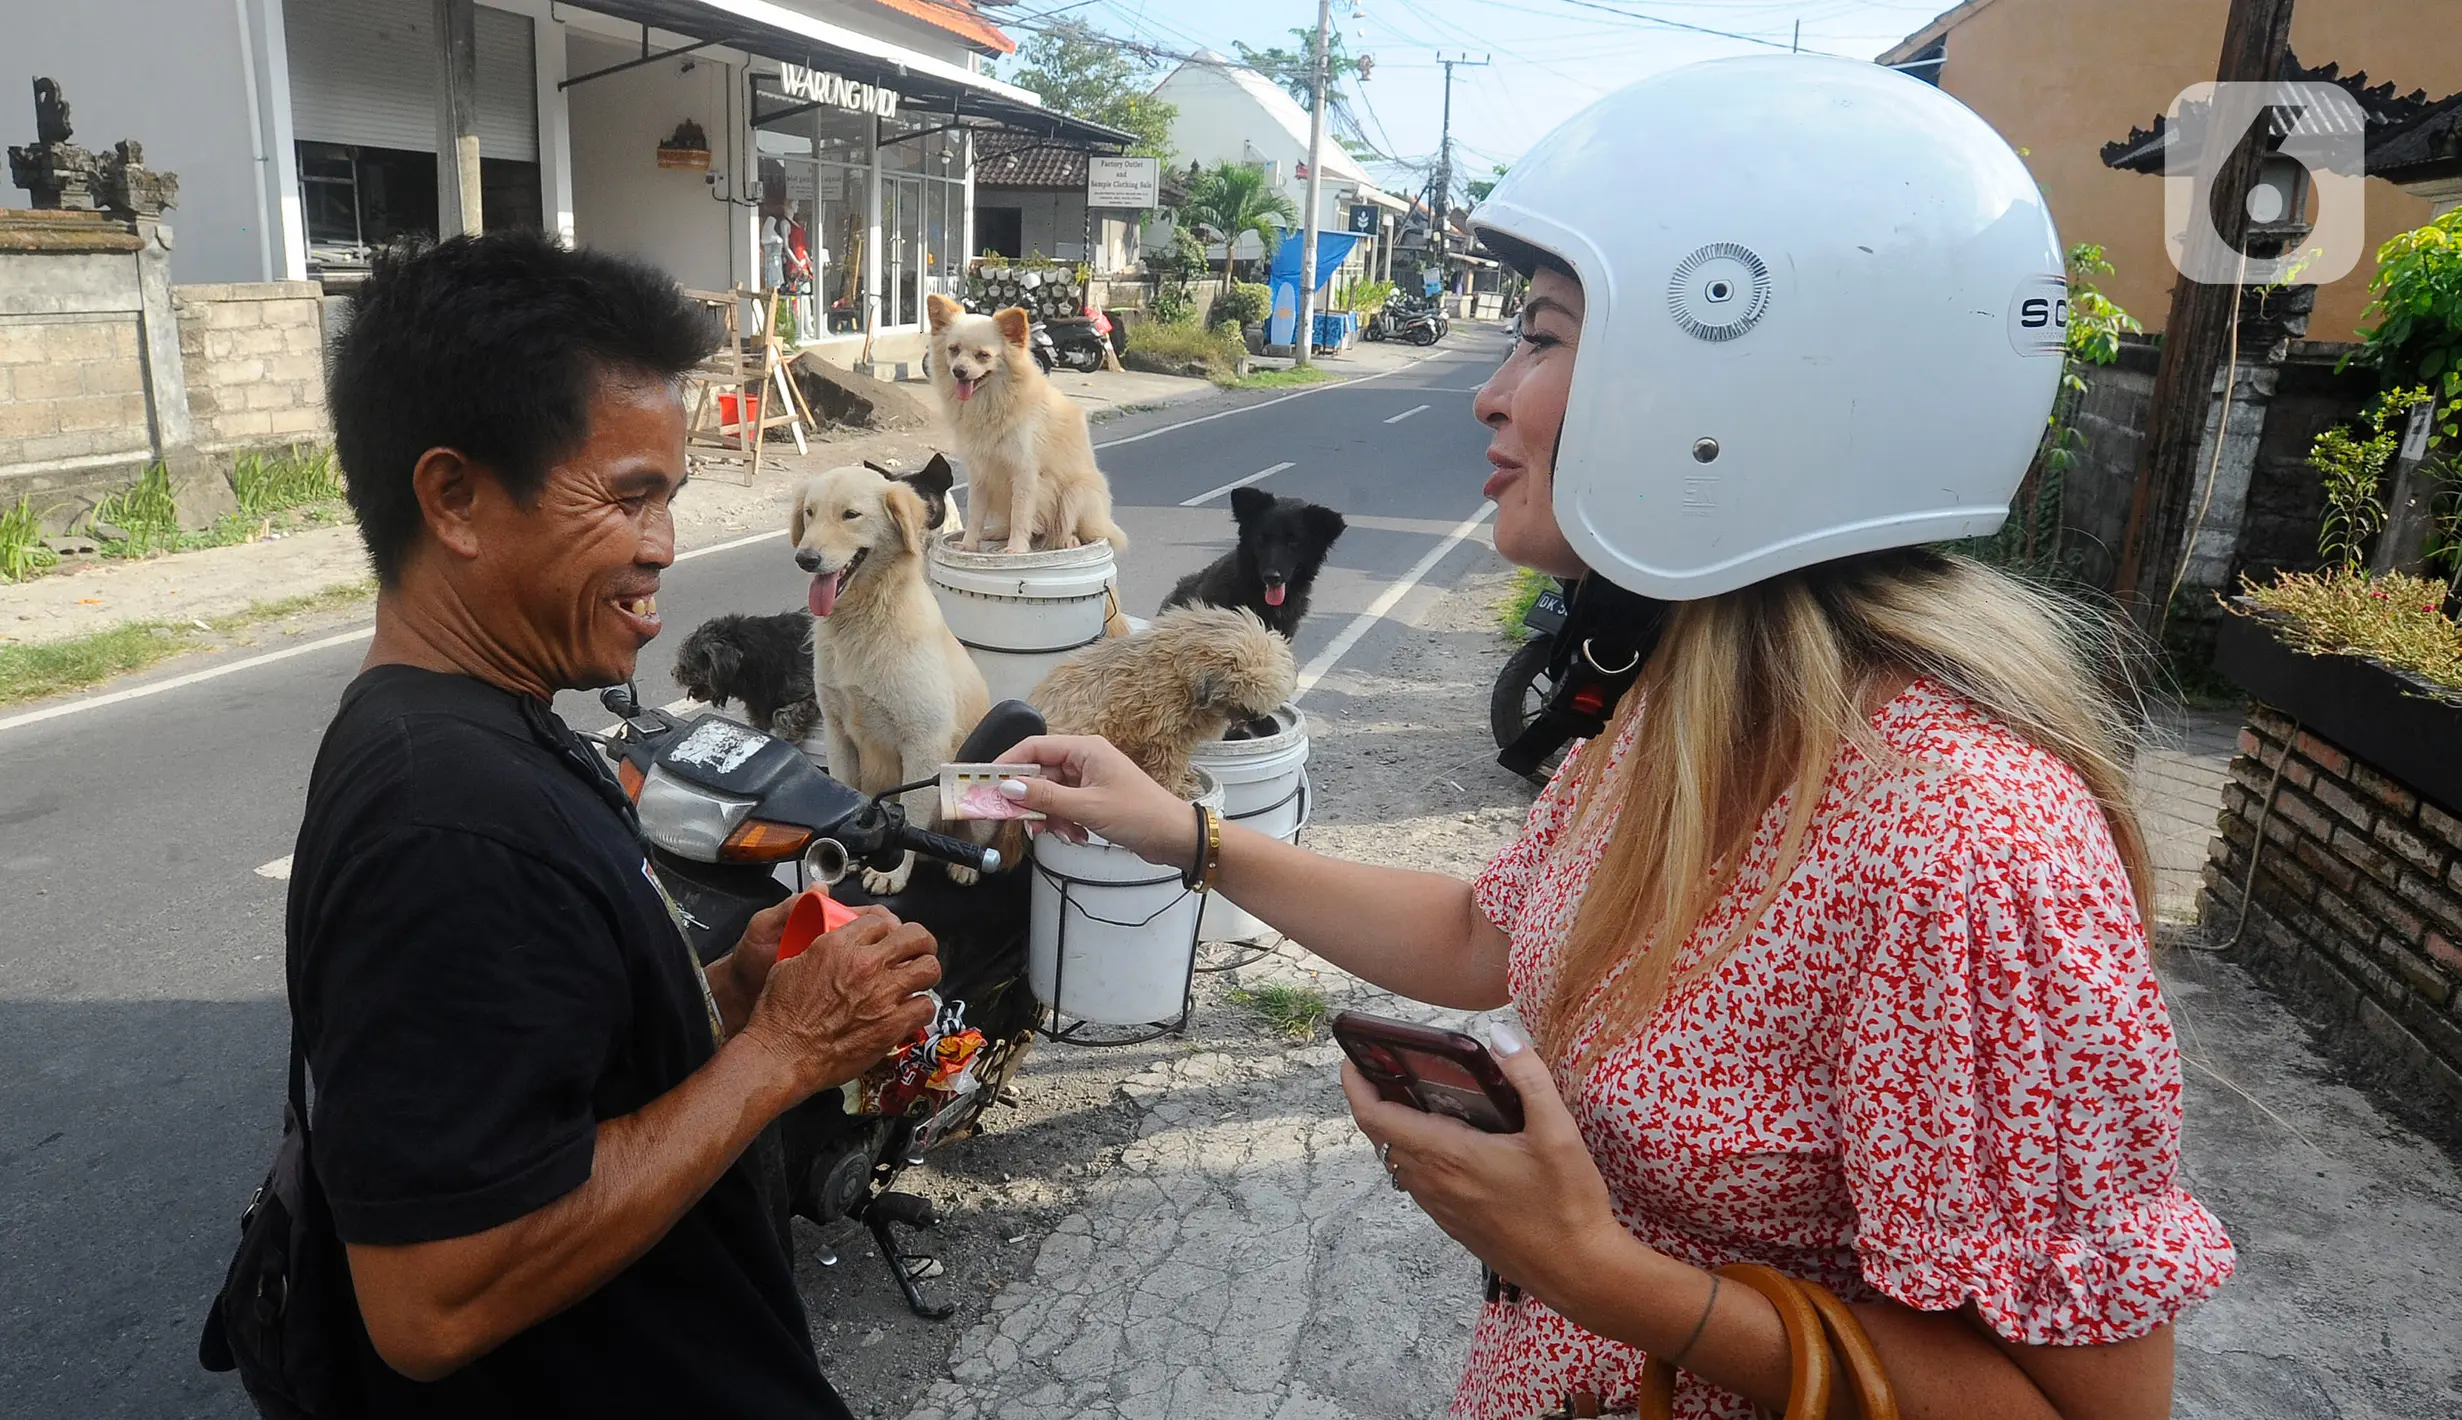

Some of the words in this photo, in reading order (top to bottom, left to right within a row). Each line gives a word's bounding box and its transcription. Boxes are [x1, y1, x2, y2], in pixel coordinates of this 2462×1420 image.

[781, 62, 861, 110] WARUNG
[861, 83, 898, 118] WIDI
[1101, 160, 1123, 169] Factory
[1124, 160, 1143, 168] Outlet
[1090, 180, 1112, 189] Sample
[1113, 181, 1138, 189] Clothing
[1539, 595, 1559, 611] DK
